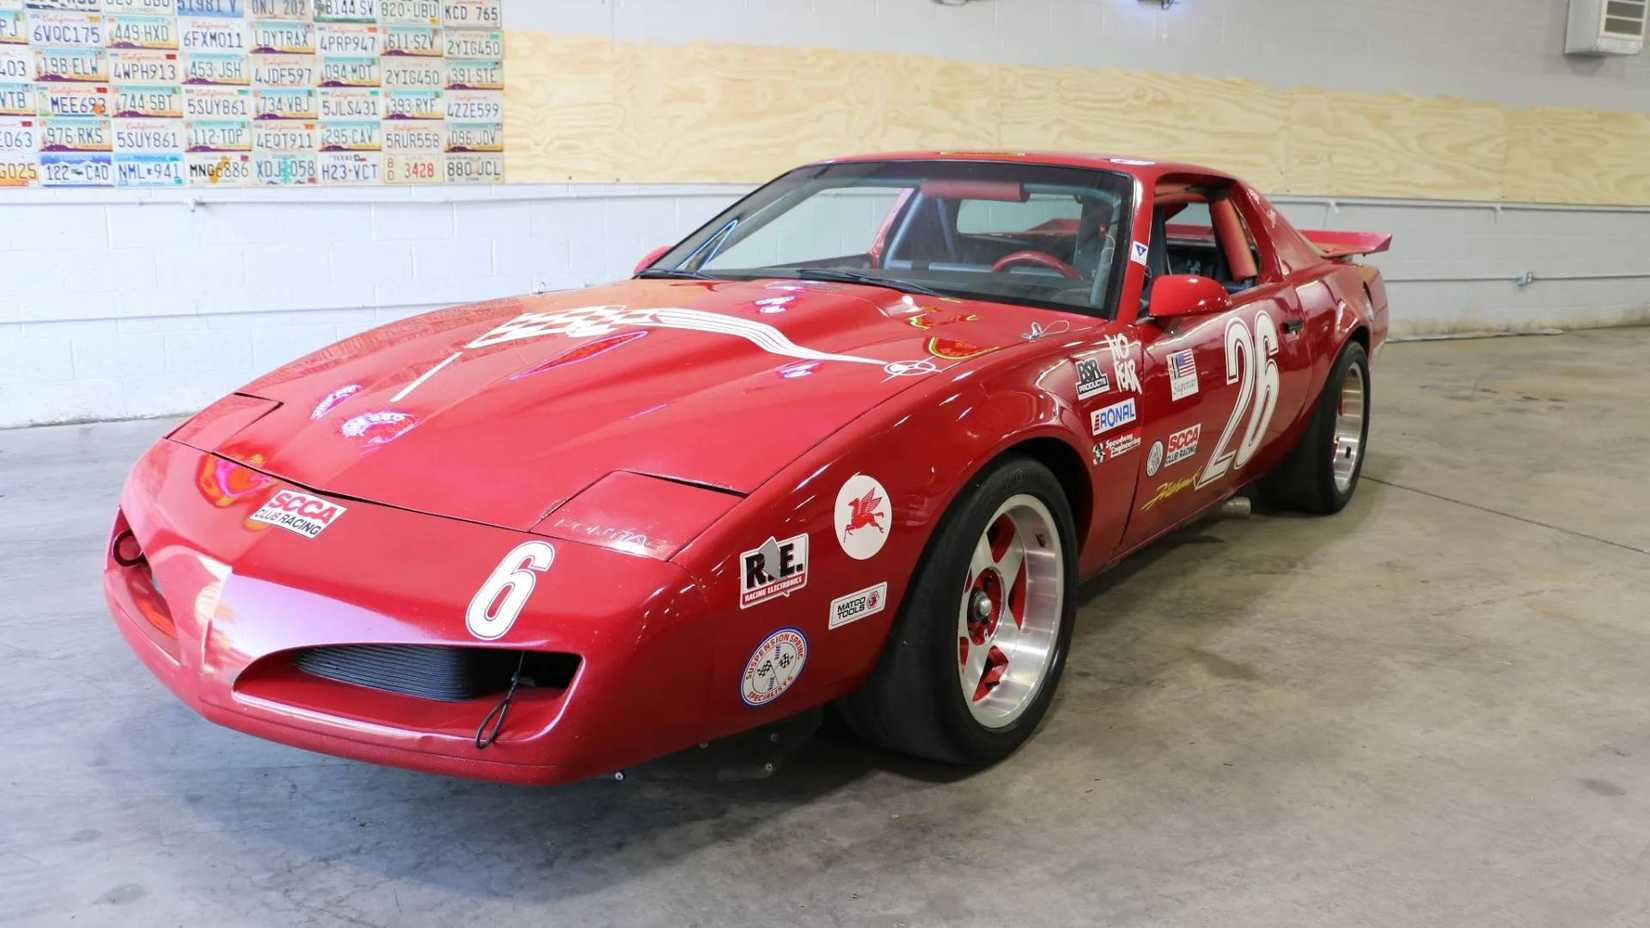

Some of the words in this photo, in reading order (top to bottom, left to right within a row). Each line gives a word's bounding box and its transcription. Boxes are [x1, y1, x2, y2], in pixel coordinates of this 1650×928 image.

[476, 6, 499, 21] 765
[113, 63, 177, 81] 4WPH913
[187, 98, 249, 116] 5SUY861
[117, 131, 179, 149] 5SUY861
[447, 160, 472, 177] 880
[1195, 310, 1280, 490] 26
[1100, 403, 1136, 429] RONAL
[1169, 426, 1199, 452] SCCA
[268, 492, 338, 525] SCCA
[279, 513, 322, 536] RACING
[465, 540, 556, 641] 6
[837, 596, 866, 612] MATCO
[837, 603, 865, 620] TOOLS
